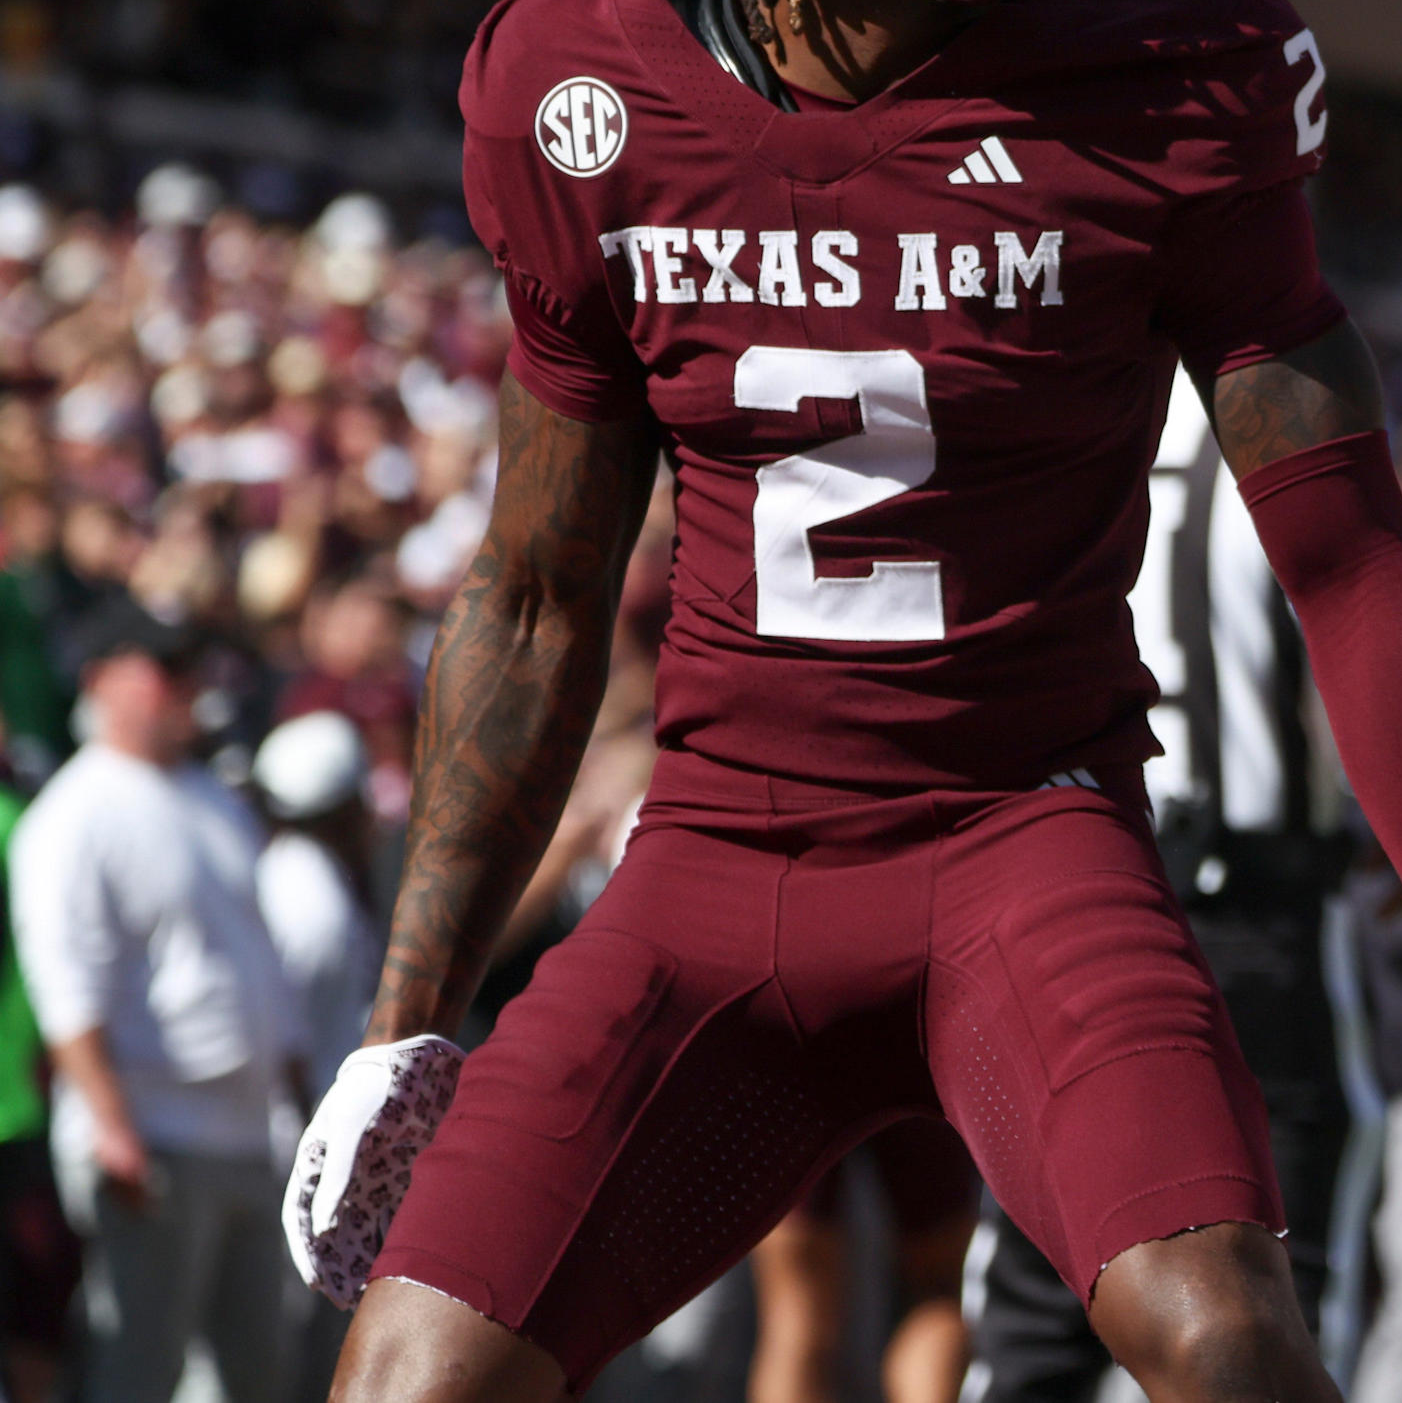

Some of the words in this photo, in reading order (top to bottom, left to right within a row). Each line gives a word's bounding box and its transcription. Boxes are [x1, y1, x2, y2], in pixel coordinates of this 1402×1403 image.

[541, 84, 622, 171] SEC
[1283, 27, 1328, 157] 2
[600, 225, 860, 309] TEXAS
[895, 230, 1064, 311] A&M
[734, 345, 945, 642] 2
